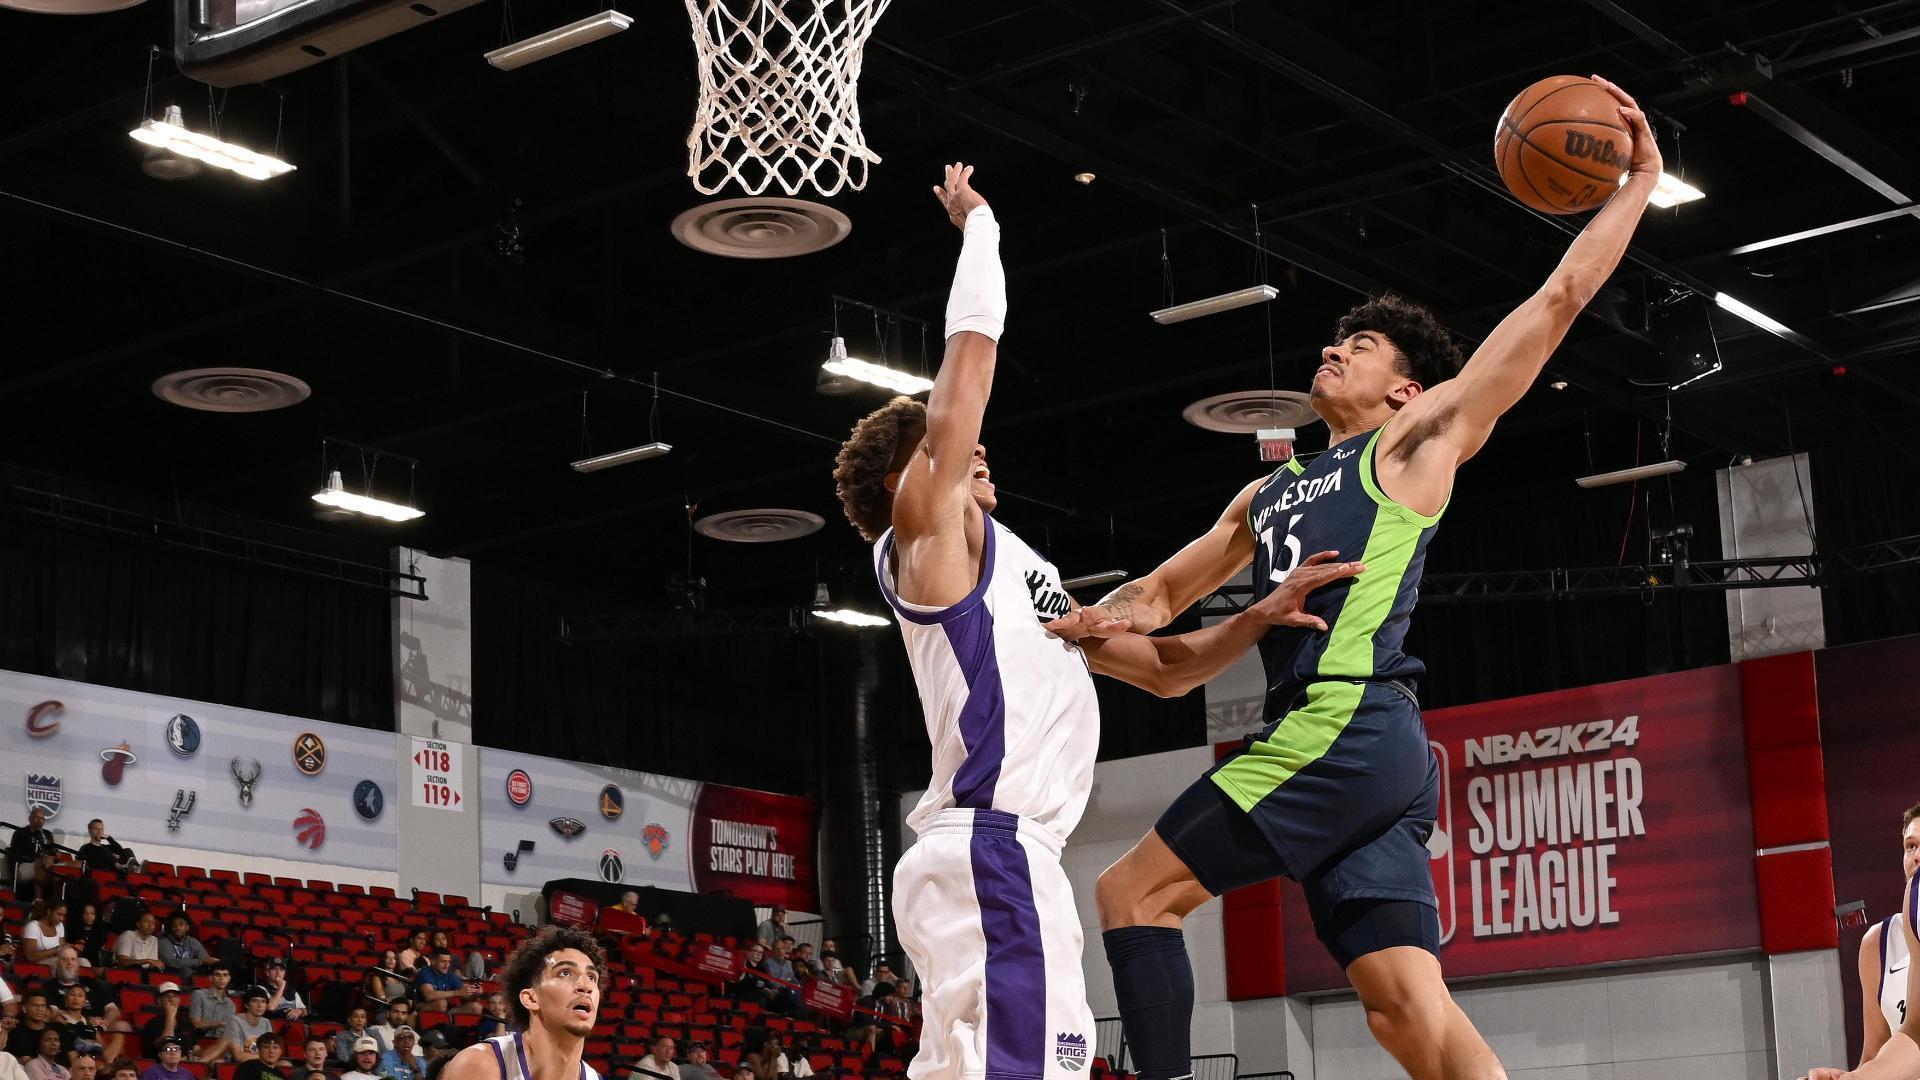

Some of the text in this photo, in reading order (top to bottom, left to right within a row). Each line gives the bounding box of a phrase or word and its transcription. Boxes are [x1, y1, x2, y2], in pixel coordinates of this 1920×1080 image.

[1024, 569, 1072, 619] King
[426, 741, 447, 751] SECTION
[1465, 715, 1640, 768] NBA2K24
[424, 749, 451, 773] 118
[426, 774, 448, 785] SECTION
[27, 789, 61, 802] KINGS
[423, 783, 451, 806] 119
[1467, 757, 1646, 854] SUMMER
[711, 818, 777, 851] TOMORROW'S
[710, 846, 796, 880] STARS PLAY HERE
[1470, 844, 1620, 937] LEAGUE
[1056, 1046, 1087, 1058] KINGS
